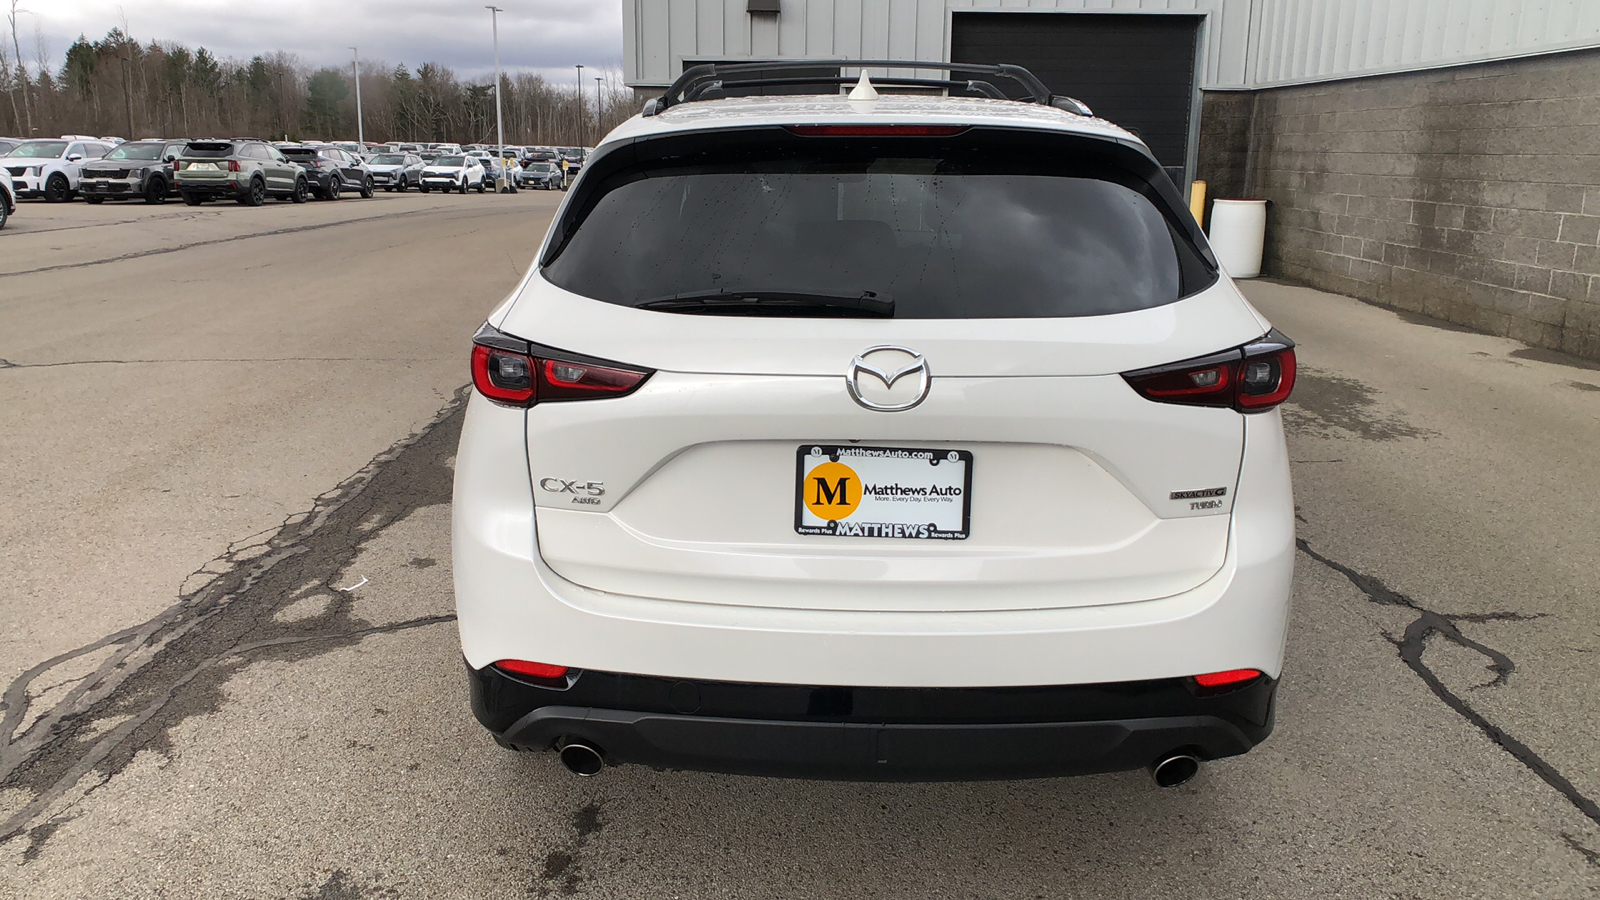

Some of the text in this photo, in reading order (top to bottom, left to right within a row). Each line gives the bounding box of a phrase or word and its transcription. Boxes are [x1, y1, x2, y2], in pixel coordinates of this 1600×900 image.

[836, 447, 934, 460] MatthewsAuto.com
[540, 477, 605, 496] CX-5
[812, 477, 851, 506] M
[863, 483, 962, 496] Matthews Auto
[1190, 499, 1223, 510] TURBO
[835, 521, 929, 538] MATTHEWS
